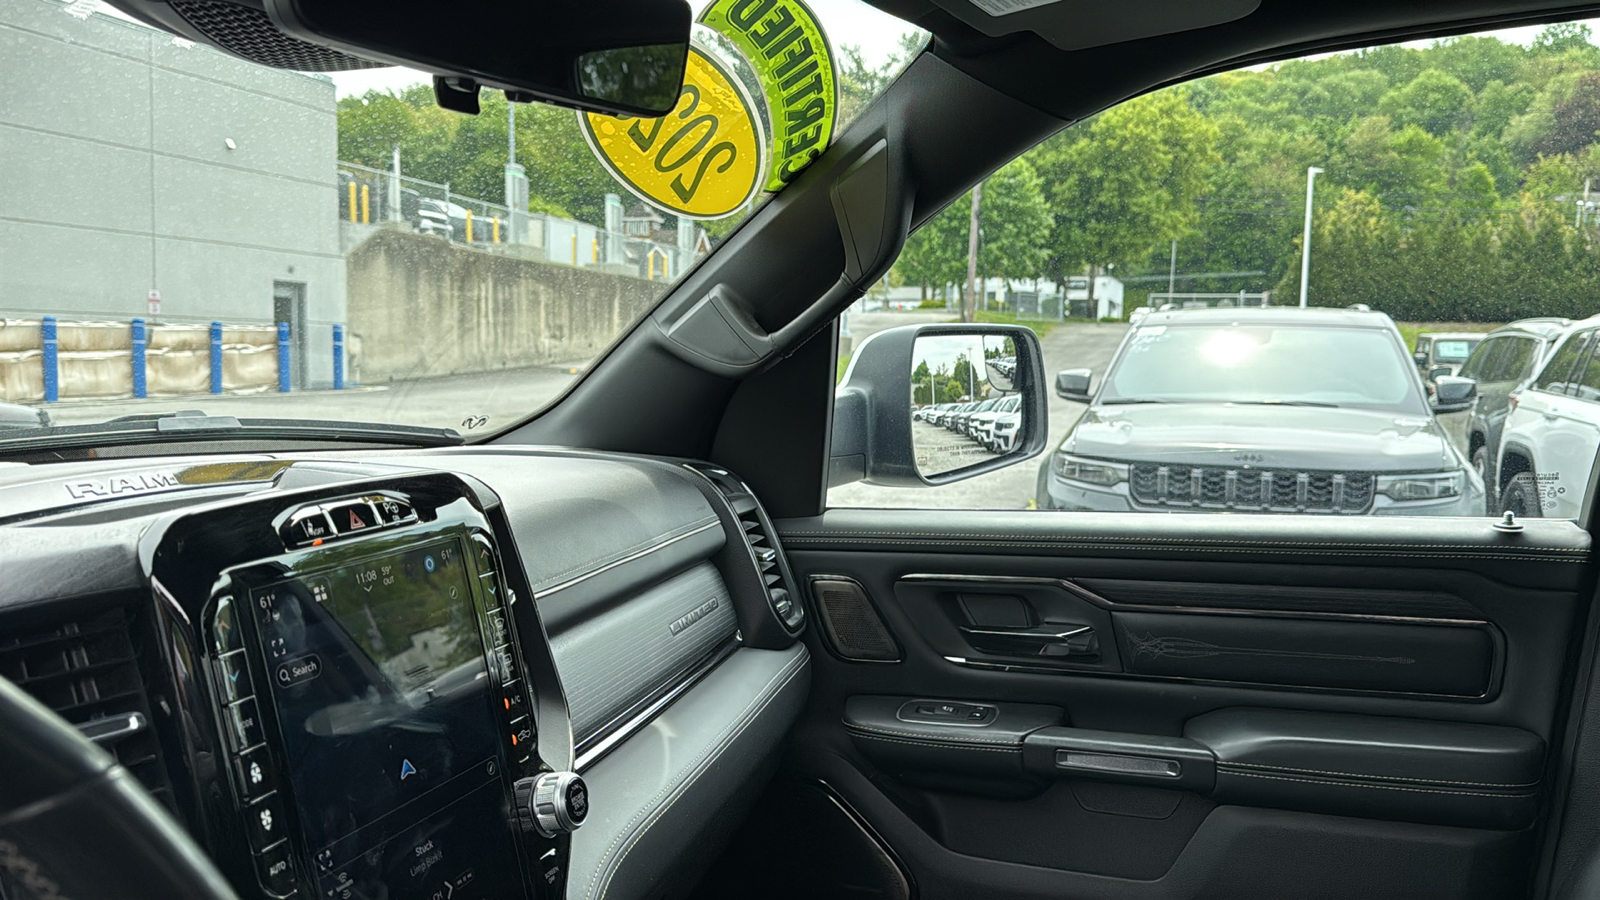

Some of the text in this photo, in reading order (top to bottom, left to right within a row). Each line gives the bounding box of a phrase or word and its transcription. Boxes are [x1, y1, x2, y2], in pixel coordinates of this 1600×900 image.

[63, 471, 180, 499] RAM
[355, 570, 377, 584] 11:08
[382, 576, 395, 586] OUT
[259, 593, 276, 609] 61°
[669, 596, 718, 637] LIMITED
[292, 661, 317, 678] Search
[510, 694, 521, 705] A/C
[415, 839, 434, 857] Stuck
[269, 860, 287, 877] AUTO
[409, 851, 444, 877] Limp Bizkit
